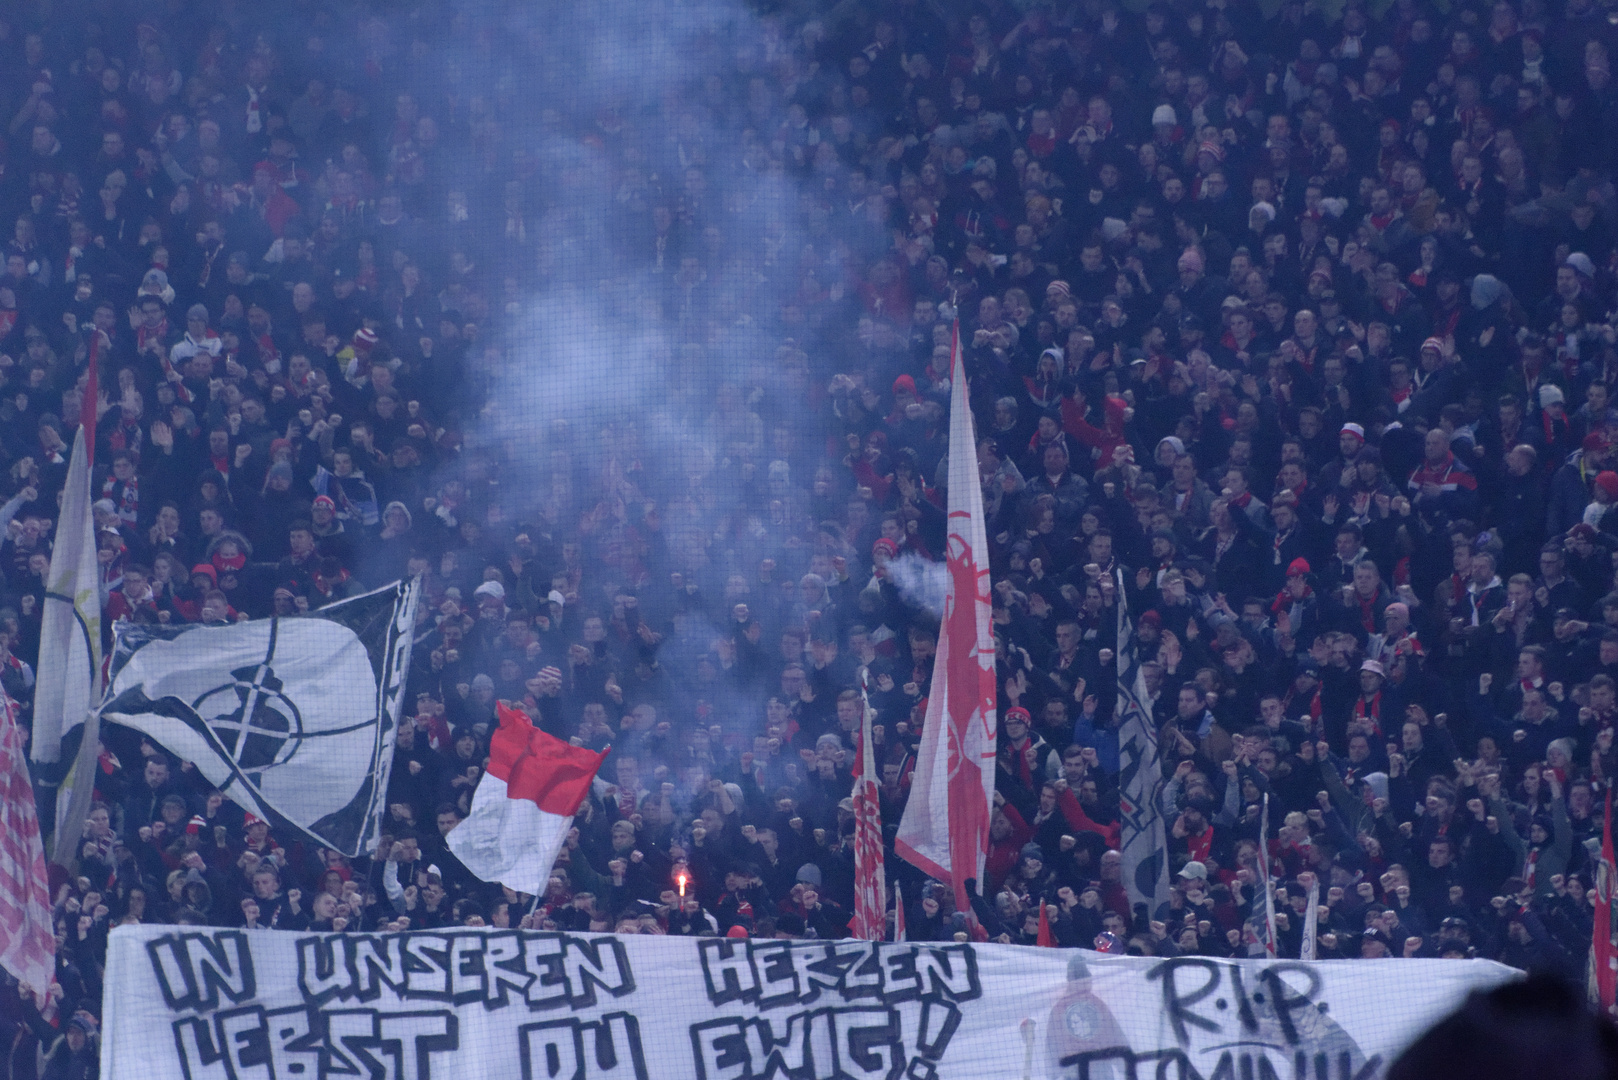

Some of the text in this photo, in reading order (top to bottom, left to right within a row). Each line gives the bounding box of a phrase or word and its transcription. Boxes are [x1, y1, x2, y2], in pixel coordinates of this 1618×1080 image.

[147, 930, 982, 1011] IN UNSEREN HERZEN
[173, 1000, 963, 1080] LEBST DU EWIG!
